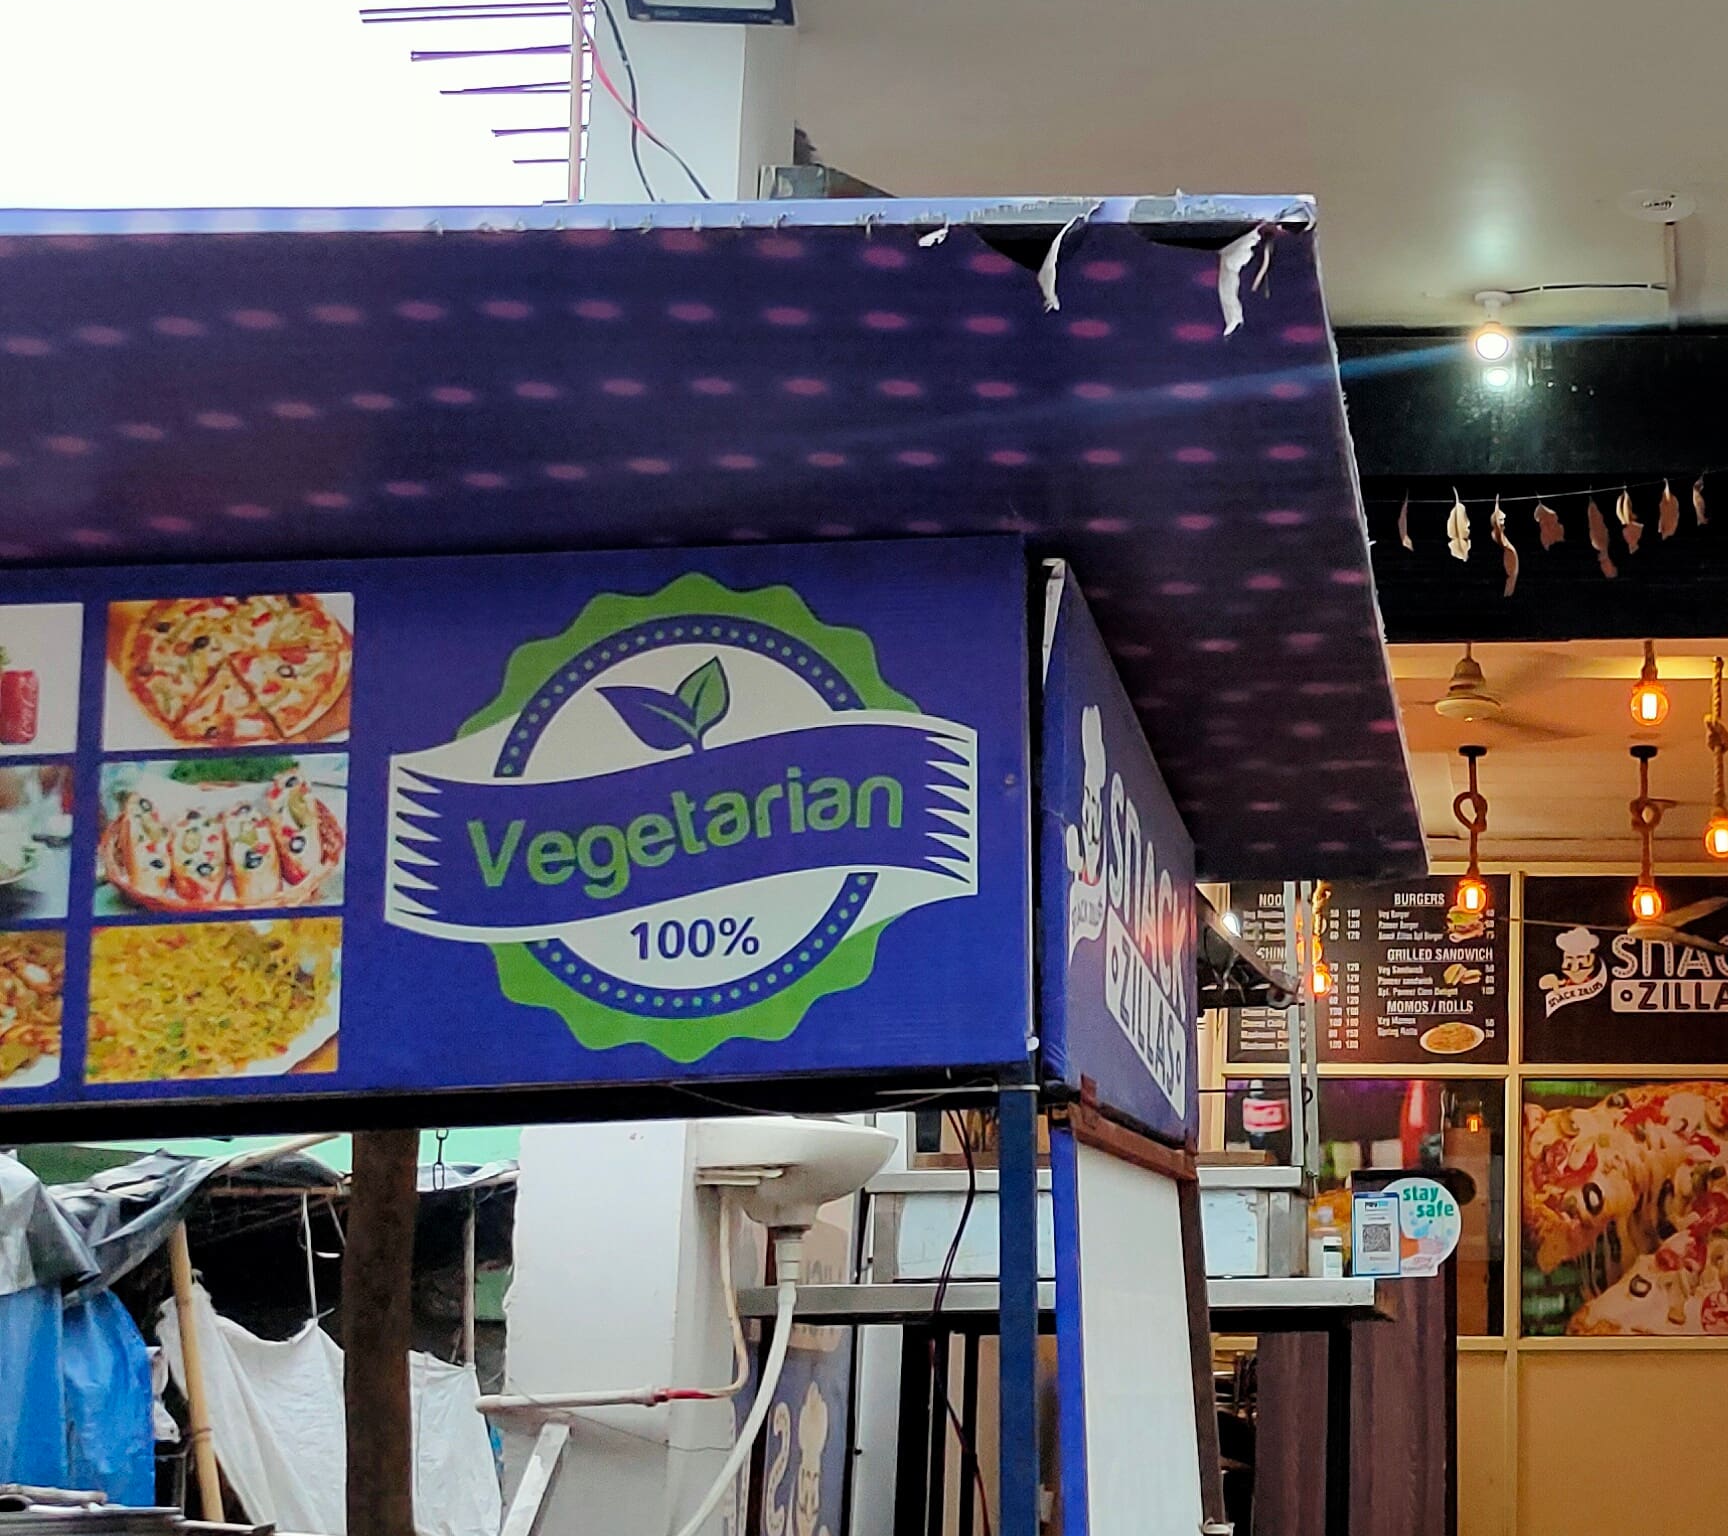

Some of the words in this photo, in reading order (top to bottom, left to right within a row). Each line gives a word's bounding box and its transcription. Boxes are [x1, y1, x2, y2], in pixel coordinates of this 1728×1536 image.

[468, 767, 904, 899] Vegetarian
[1394, 892, 1445, 905] BURGERS
[630, 916, 760, 962] 100%
[1387, 947, 1432, 961] GRILLED
[1435, 946, 1493, 961] SANDWICH
[1387, 1000, 1429, 1013] MOMOS
[1438, 999, 1474, 1013] ROLLS
[1119, 934, 1175, 1098] ZILLAS
[1402, 1185, 1439, 1203] stay
[1416, 1199, 1455, 1218] safe
